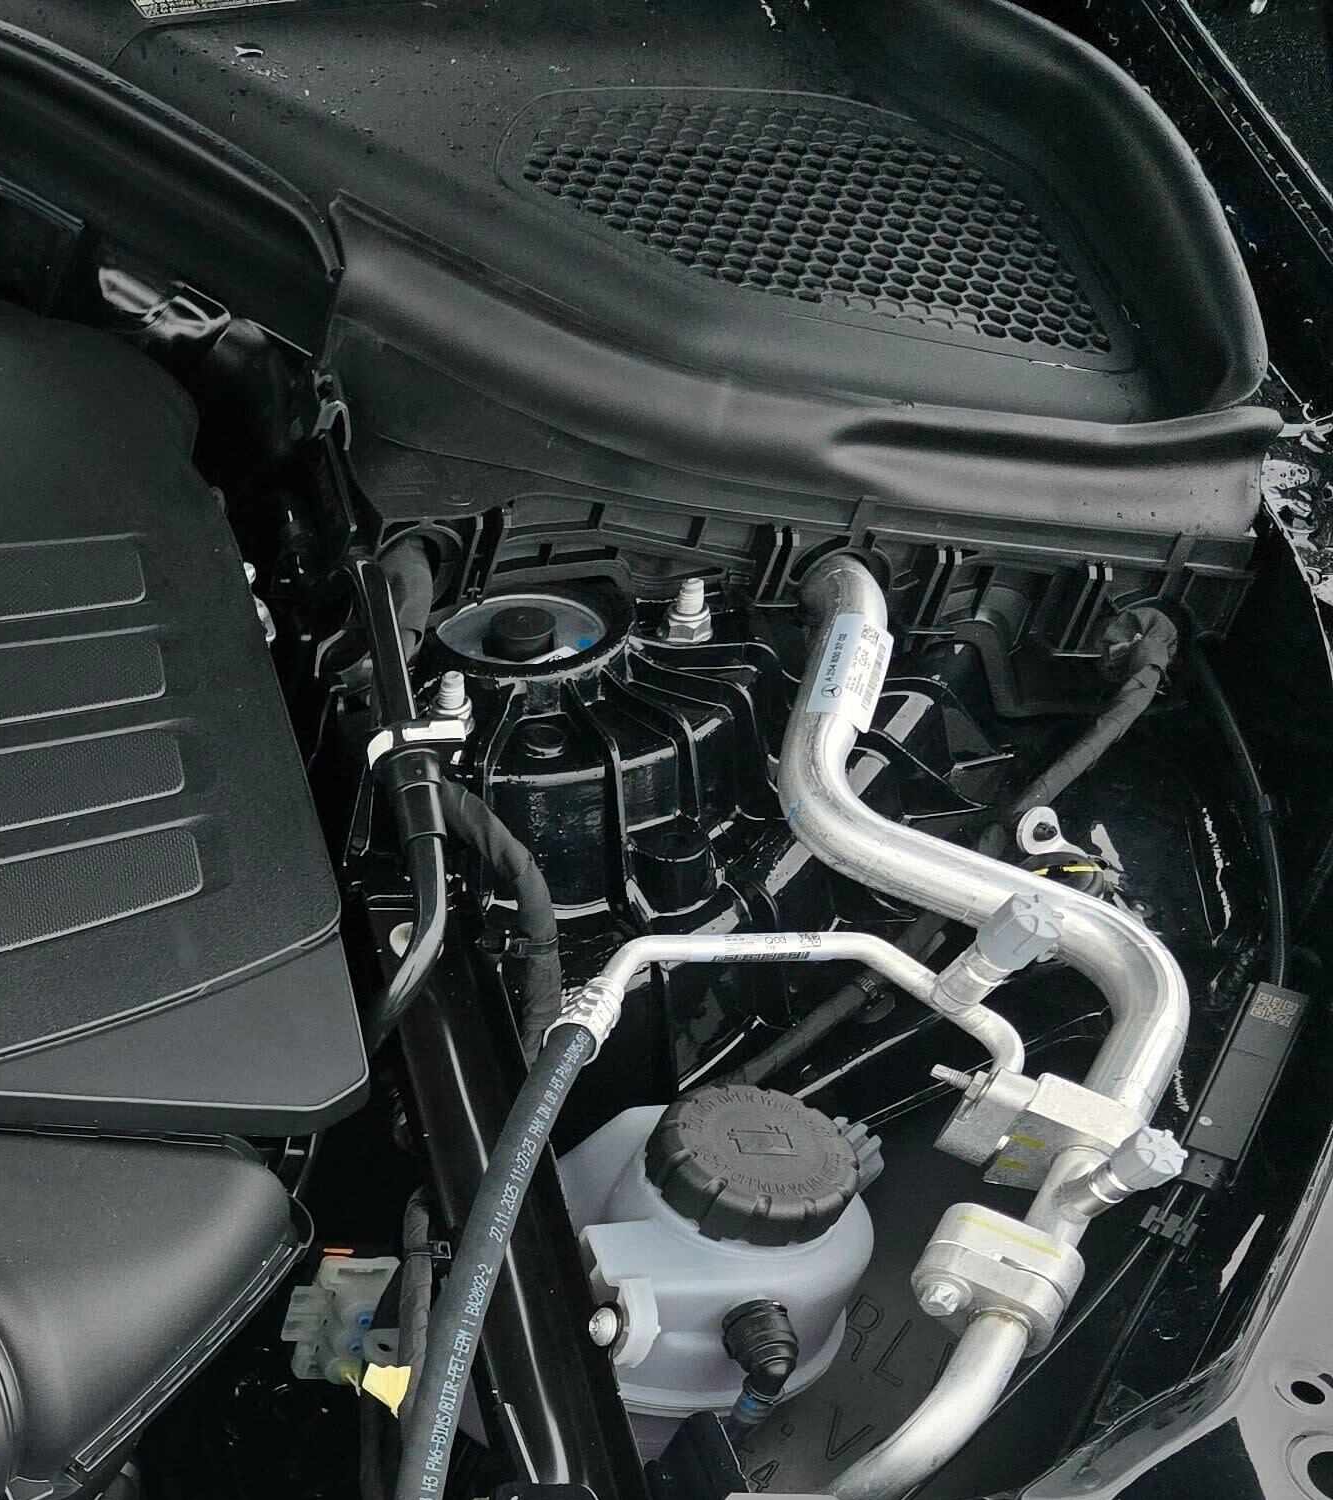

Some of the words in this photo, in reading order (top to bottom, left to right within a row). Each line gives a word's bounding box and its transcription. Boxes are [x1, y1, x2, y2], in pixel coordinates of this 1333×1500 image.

[421, 1474, 439, 1493] H3
[464, 1263, 493, 1317] BA2892-2
[489, 1182, 520, 1244] 27.11.2025
[509, 1136, 538, 1183] 11:27:23
[536, 1101, 553, 1120] DN
